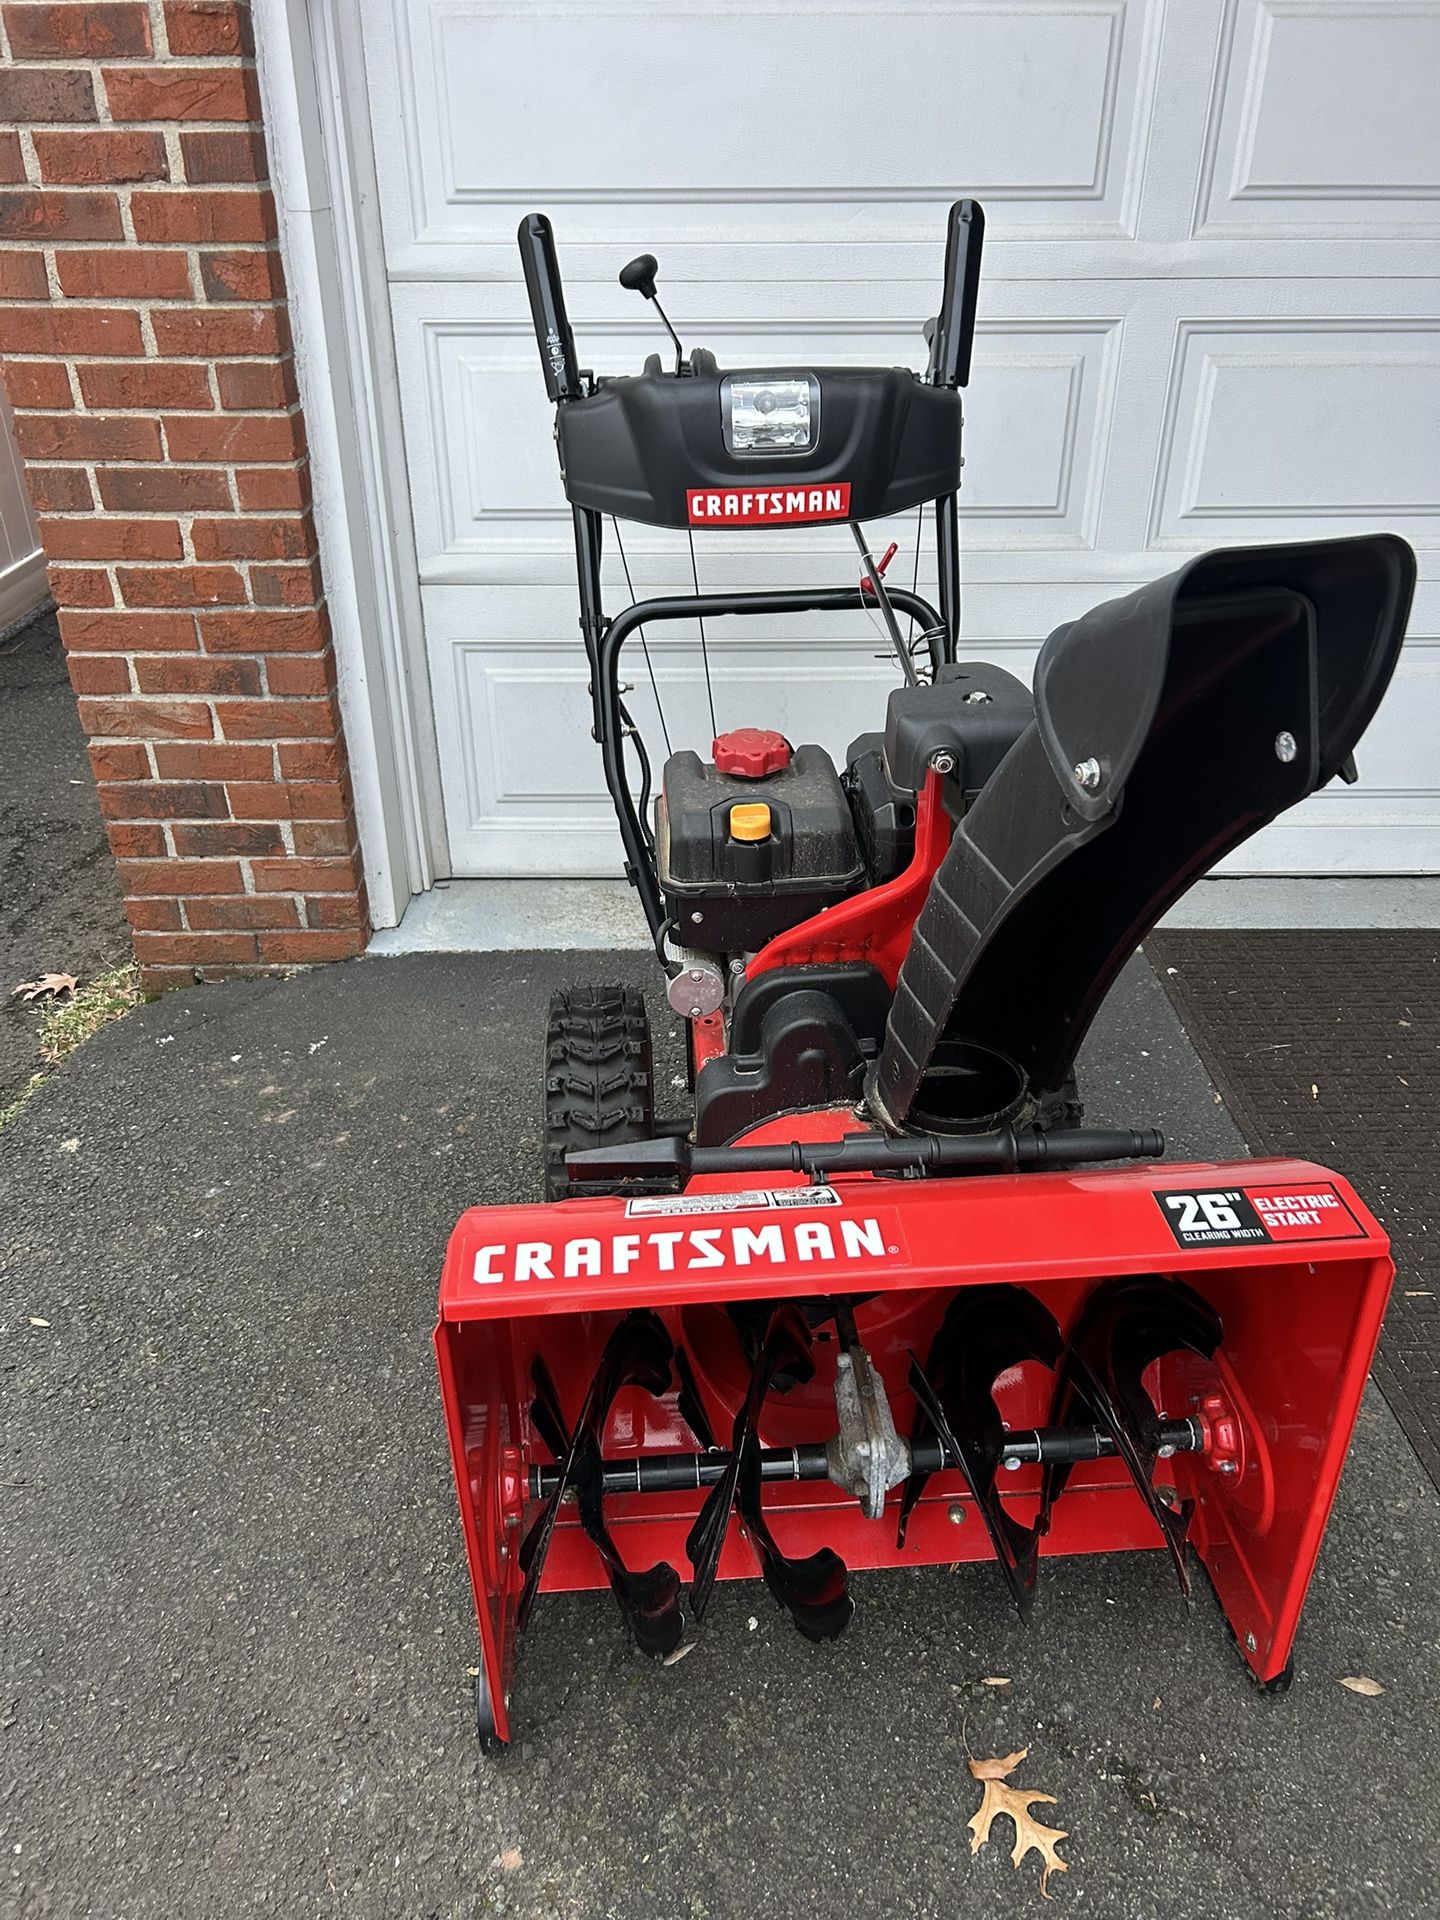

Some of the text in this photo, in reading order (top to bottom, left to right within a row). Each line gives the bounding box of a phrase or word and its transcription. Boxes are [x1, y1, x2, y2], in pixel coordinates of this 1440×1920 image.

[692, 489, 841, 517] CRAFTSMAN
[1165, 1192, 1242, 1231] 26"
[1253, 1194, 1339, 1212] ELECTRIC
[1262, 1210, 1322, 1227] START
[1182, 1228, 1264, 1242] CLEARING WIDTH
[473, 1218, 886, 1284] CRAFTSMAN
